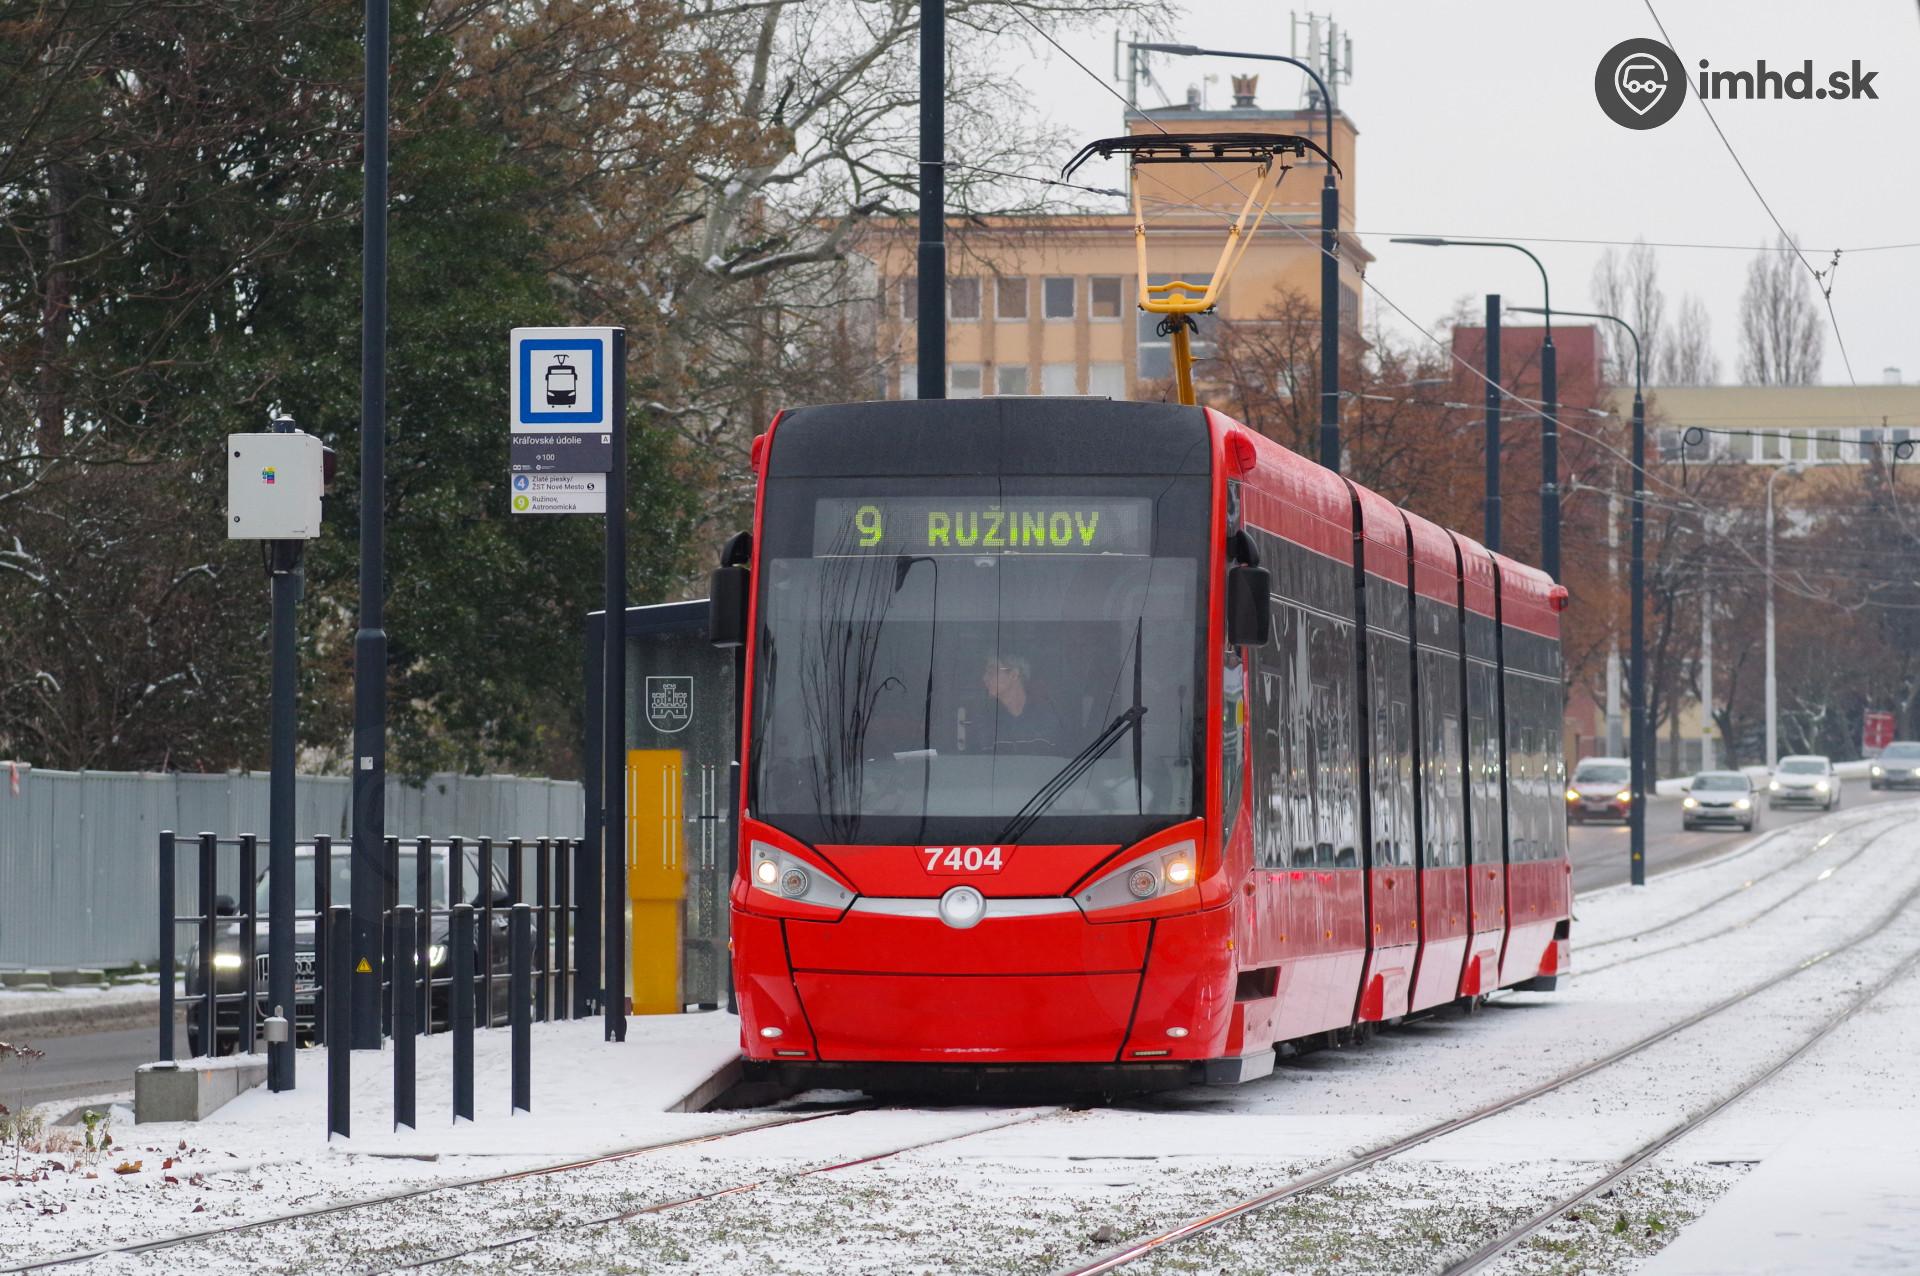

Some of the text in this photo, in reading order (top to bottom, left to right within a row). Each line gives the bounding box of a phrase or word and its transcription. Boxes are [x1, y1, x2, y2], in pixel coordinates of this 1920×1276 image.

[513, 436, 582, 445] Kráľovské údolie
[517, 478, 525, 489] 4
[518, 497, 525, 507] 9
[532, 503, 576, 511] Astronomická
[855, 505, 1099, 546] 9 RUŽINOV
[924, 847, 1003, 871] 7404
